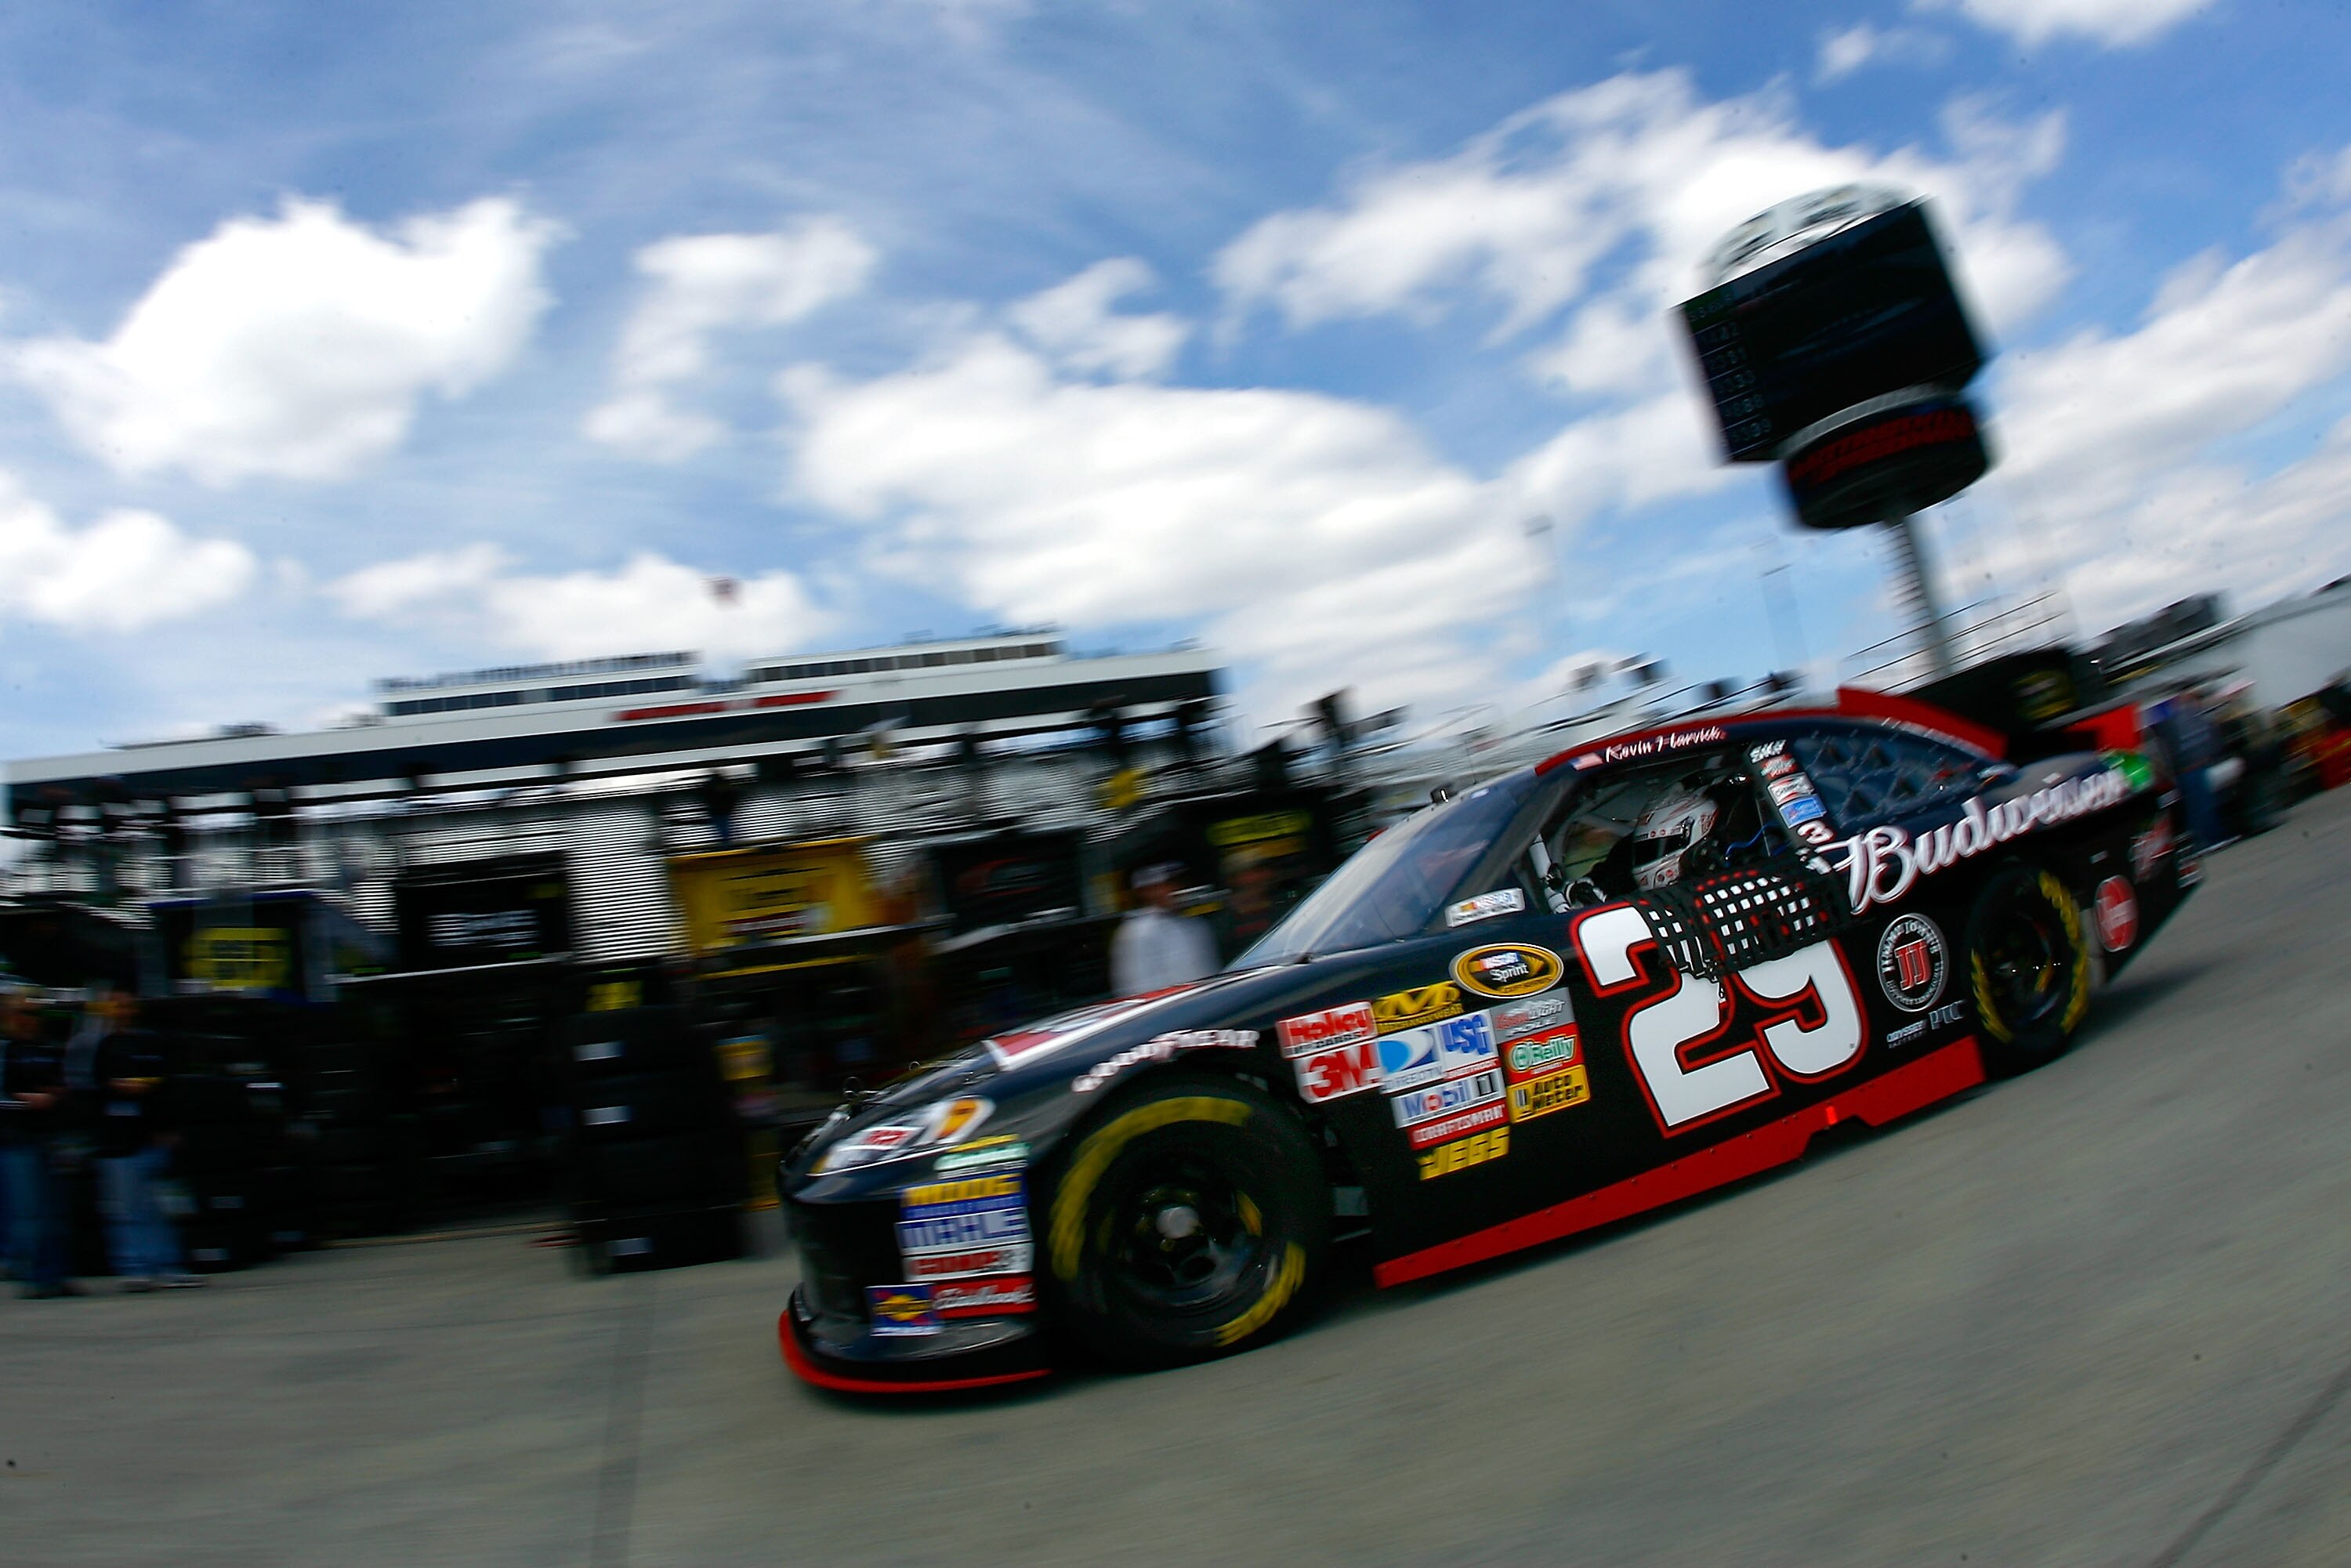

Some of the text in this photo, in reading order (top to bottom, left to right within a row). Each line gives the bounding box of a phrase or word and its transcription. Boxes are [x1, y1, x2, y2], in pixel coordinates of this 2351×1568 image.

[1606, 741, 1652, 763] Kevin
[1796, 819, 1835, 845] 3
[1814, 770, 2128, 915] Budweiser
[1490, 962, 1530, 983] Sprint
[1280, 1009, 1377, 1048] Holley
[1571, 900, 1869, 1136] 29
[1304, 1042, 1378, 1098] 3M
[1402, 1075, 1470, 1118] Mobil
